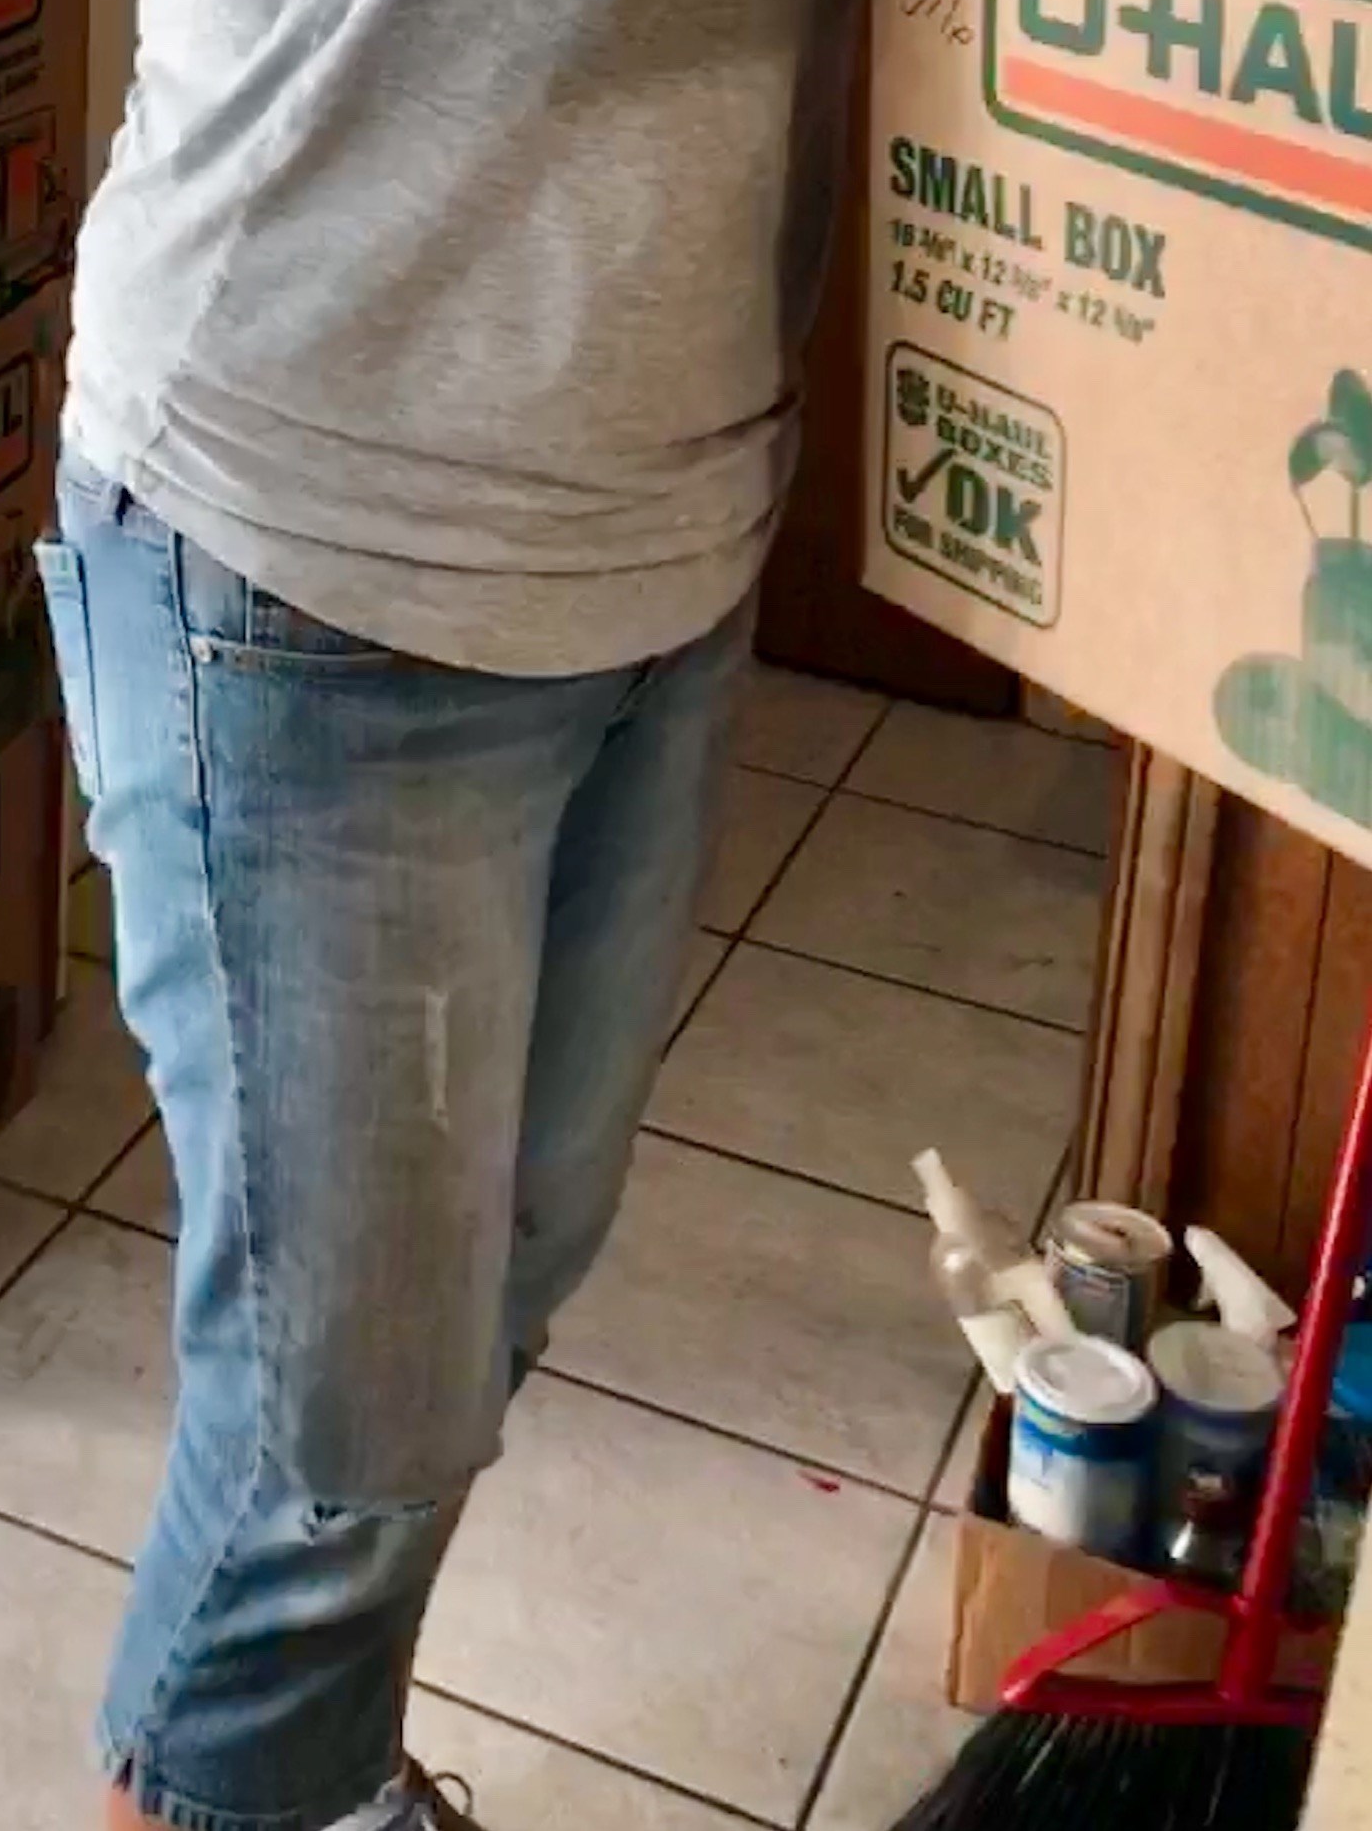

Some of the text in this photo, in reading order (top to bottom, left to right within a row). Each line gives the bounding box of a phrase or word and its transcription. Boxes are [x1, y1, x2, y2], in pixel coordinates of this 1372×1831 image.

[889, 136, 1166, 300] SMALL BOX
[891, 259, 1016, 343] 1.5 CU FT
[980, 250, 1007, 286] 12
[1077, 291, 1107, 328] 12
[936, 381, 1053, 461] U-HAUL
[936, 415, 1053, 493] BOXES
[945, 462, 1044, 568] OK
